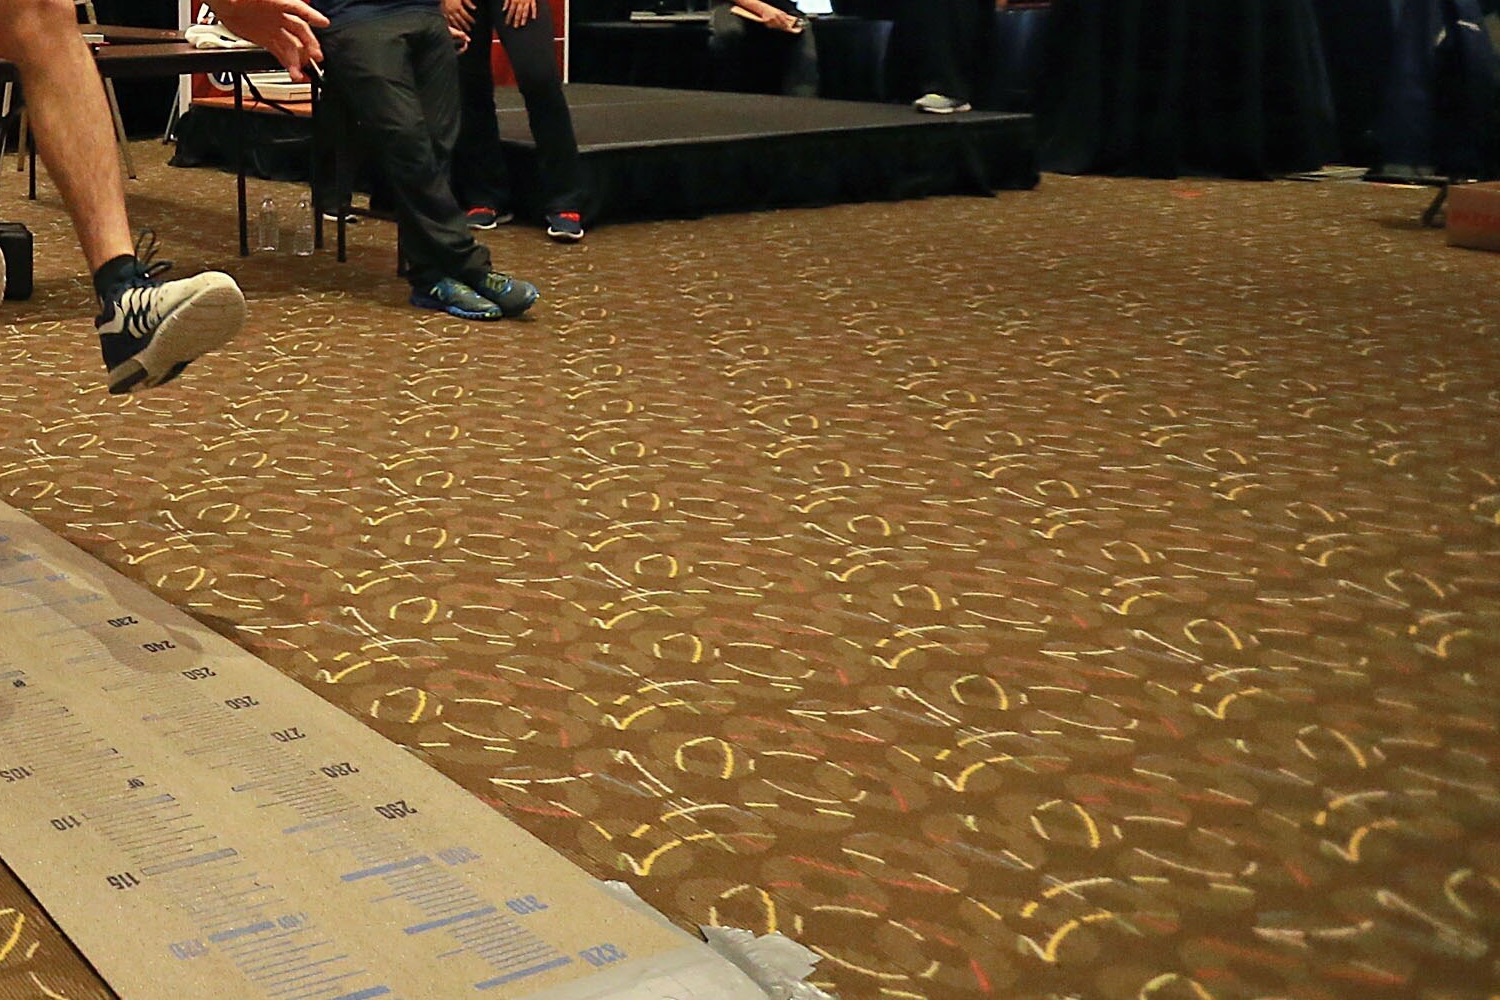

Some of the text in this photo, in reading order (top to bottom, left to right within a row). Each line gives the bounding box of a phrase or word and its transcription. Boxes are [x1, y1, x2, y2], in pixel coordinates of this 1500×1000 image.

[107, 615, 138, 628] 230
[143, 640, 176, 653] 240
[182, 667, 216, 681] 250
[225, 695, 260, 710] 260
[271, 727, 306, 743] 270
[320, 762, 360, 779] 280
[374, 800, 418, 820] 290
[51, 816, 81, 832] 110
[107, 871, 140, 890] 115
[506, 895, 548, 915] 310
[578, 943, 629, 968] 320
